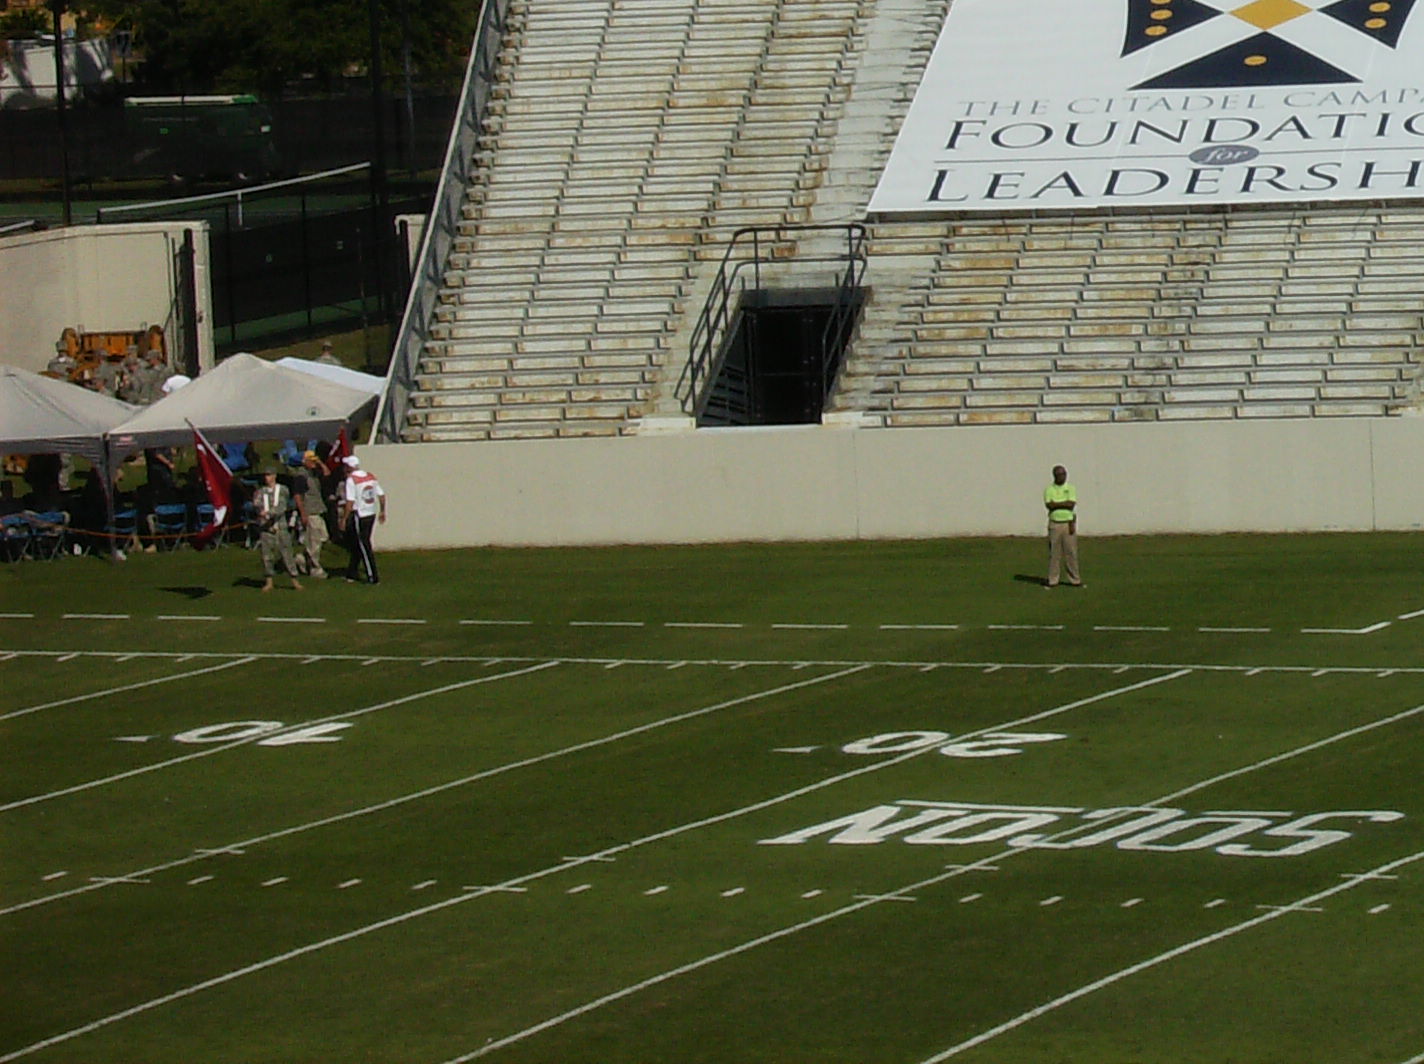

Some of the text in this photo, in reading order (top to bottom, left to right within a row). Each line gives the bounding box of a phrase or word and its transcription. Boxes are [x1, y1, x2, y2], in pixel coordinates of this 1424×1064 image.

[958, 99, 1048, 117] THE
[1067, 92, 1264, 115] CITADEL
[1205, 145, 1251, 165] for
[841, 731, 1069, 758] 20
